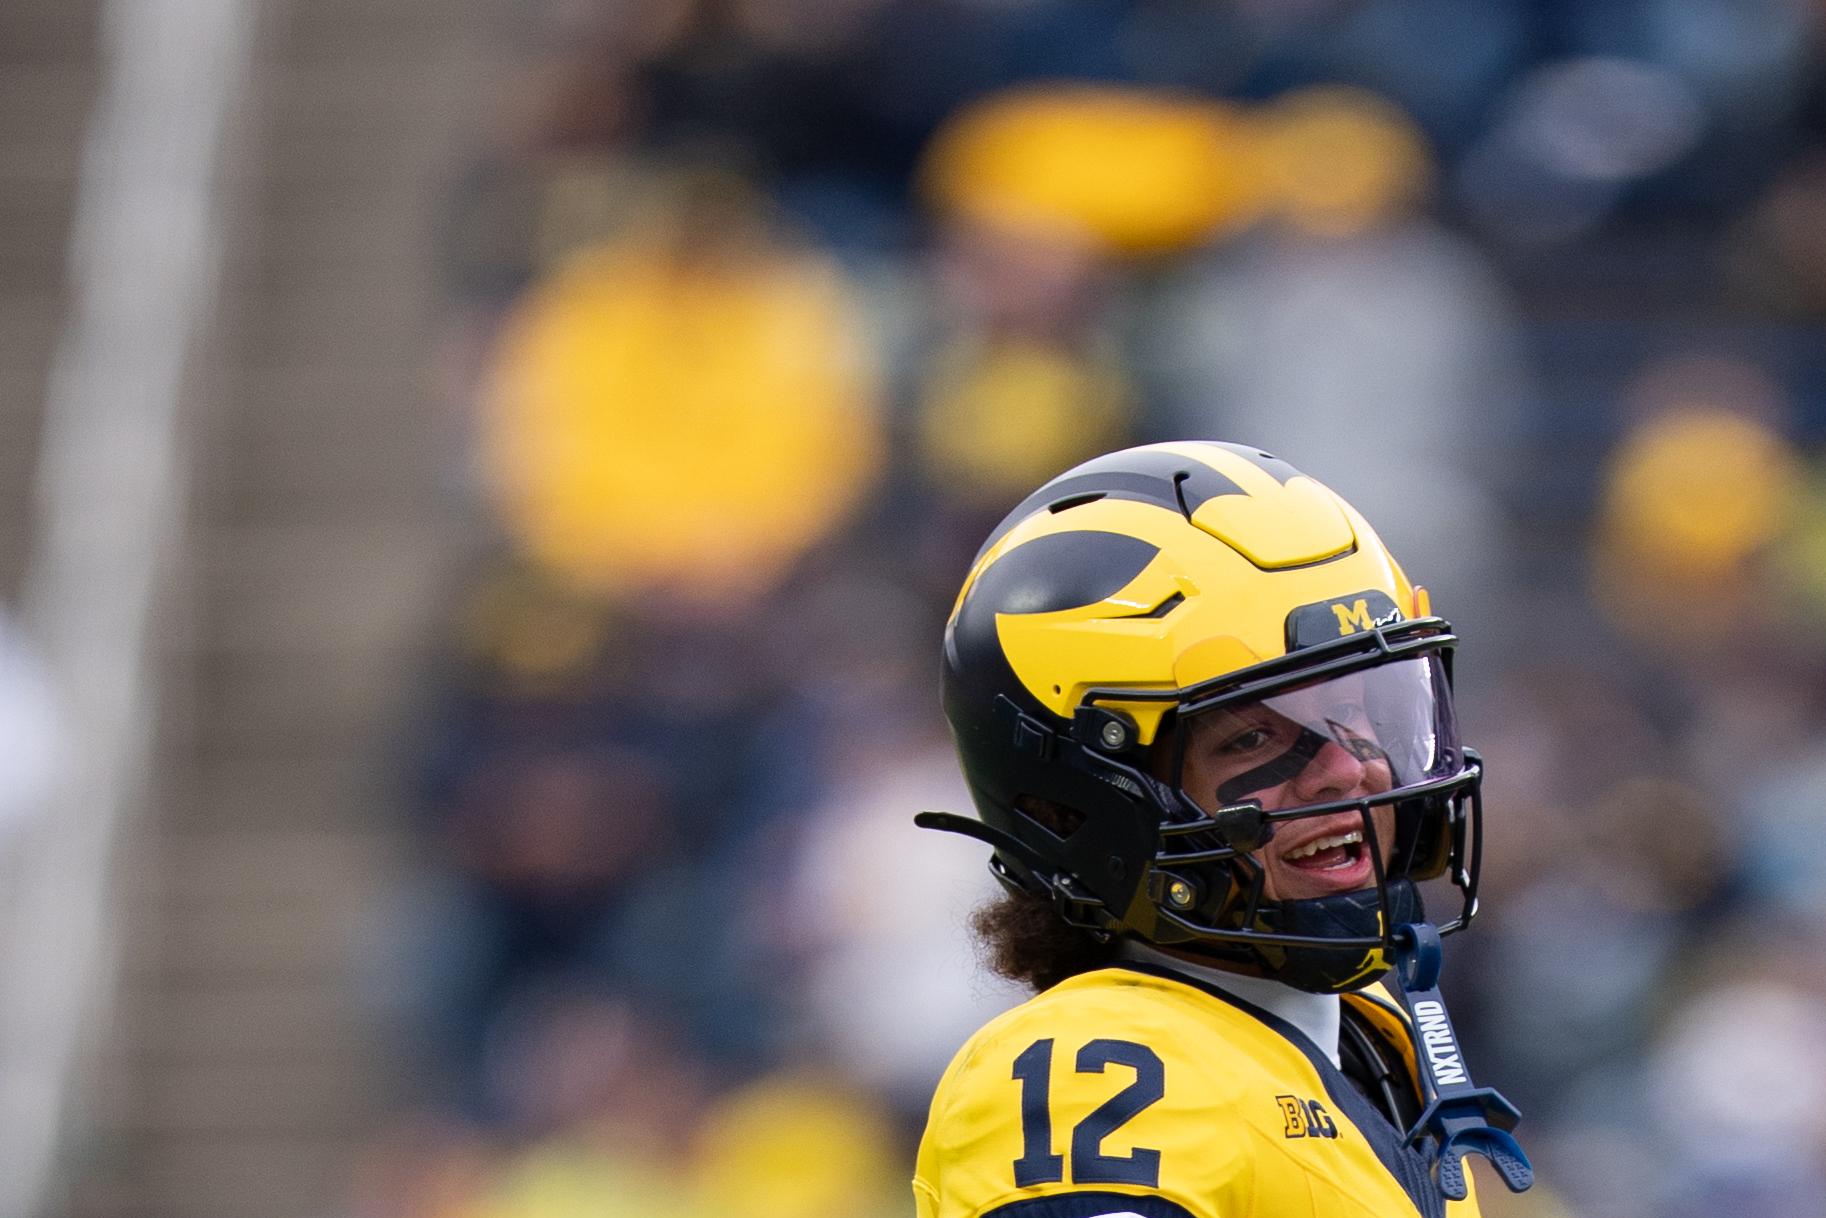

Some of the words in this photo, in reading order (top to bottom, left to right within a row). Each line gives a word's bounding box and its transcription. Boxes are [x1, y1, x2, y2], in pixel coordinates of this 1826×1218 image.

[1331, 599, 1374, 636] M
[1414, 1000, 1467, 1085] NXTRND
[1011, 1037, 1165, 1189] 12
